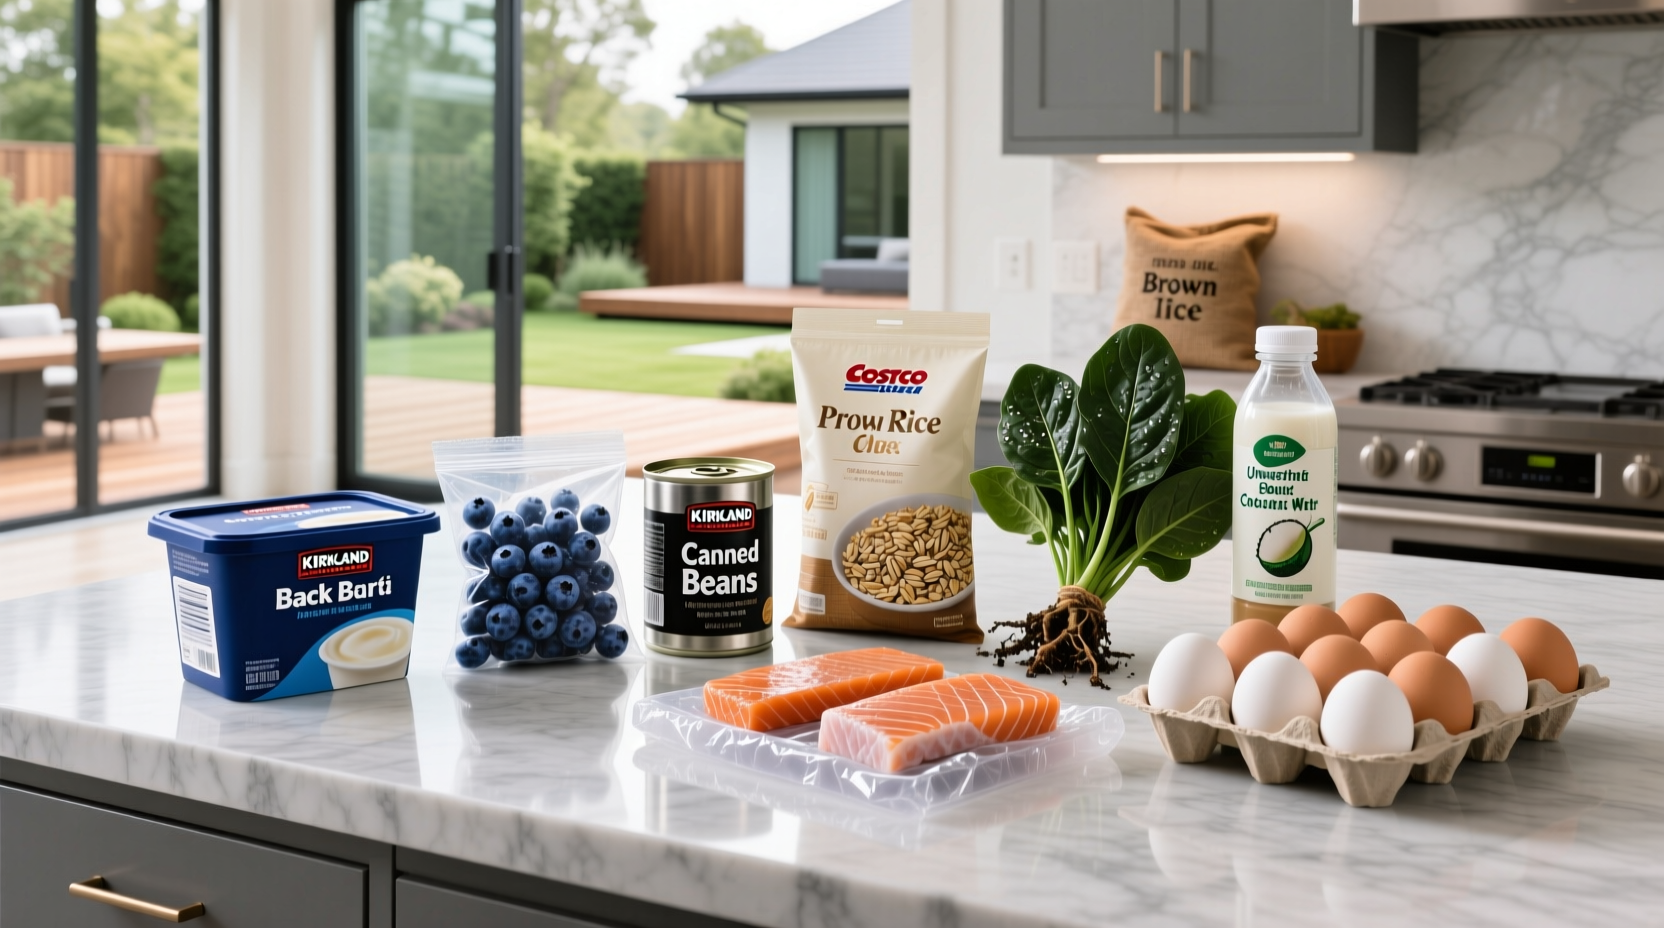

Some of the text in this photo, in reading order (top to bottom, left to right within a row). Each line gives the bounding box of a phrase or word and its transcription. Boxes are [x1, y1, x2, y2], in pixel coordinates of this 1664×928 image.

[1142, 272, 1217, 297] Brown
[887, 409, 942, 434] Rice
[681, 538, 759, 566] Canned
[682, 568, 758, 596] Beans
[275, 583, 333, 611] Back
